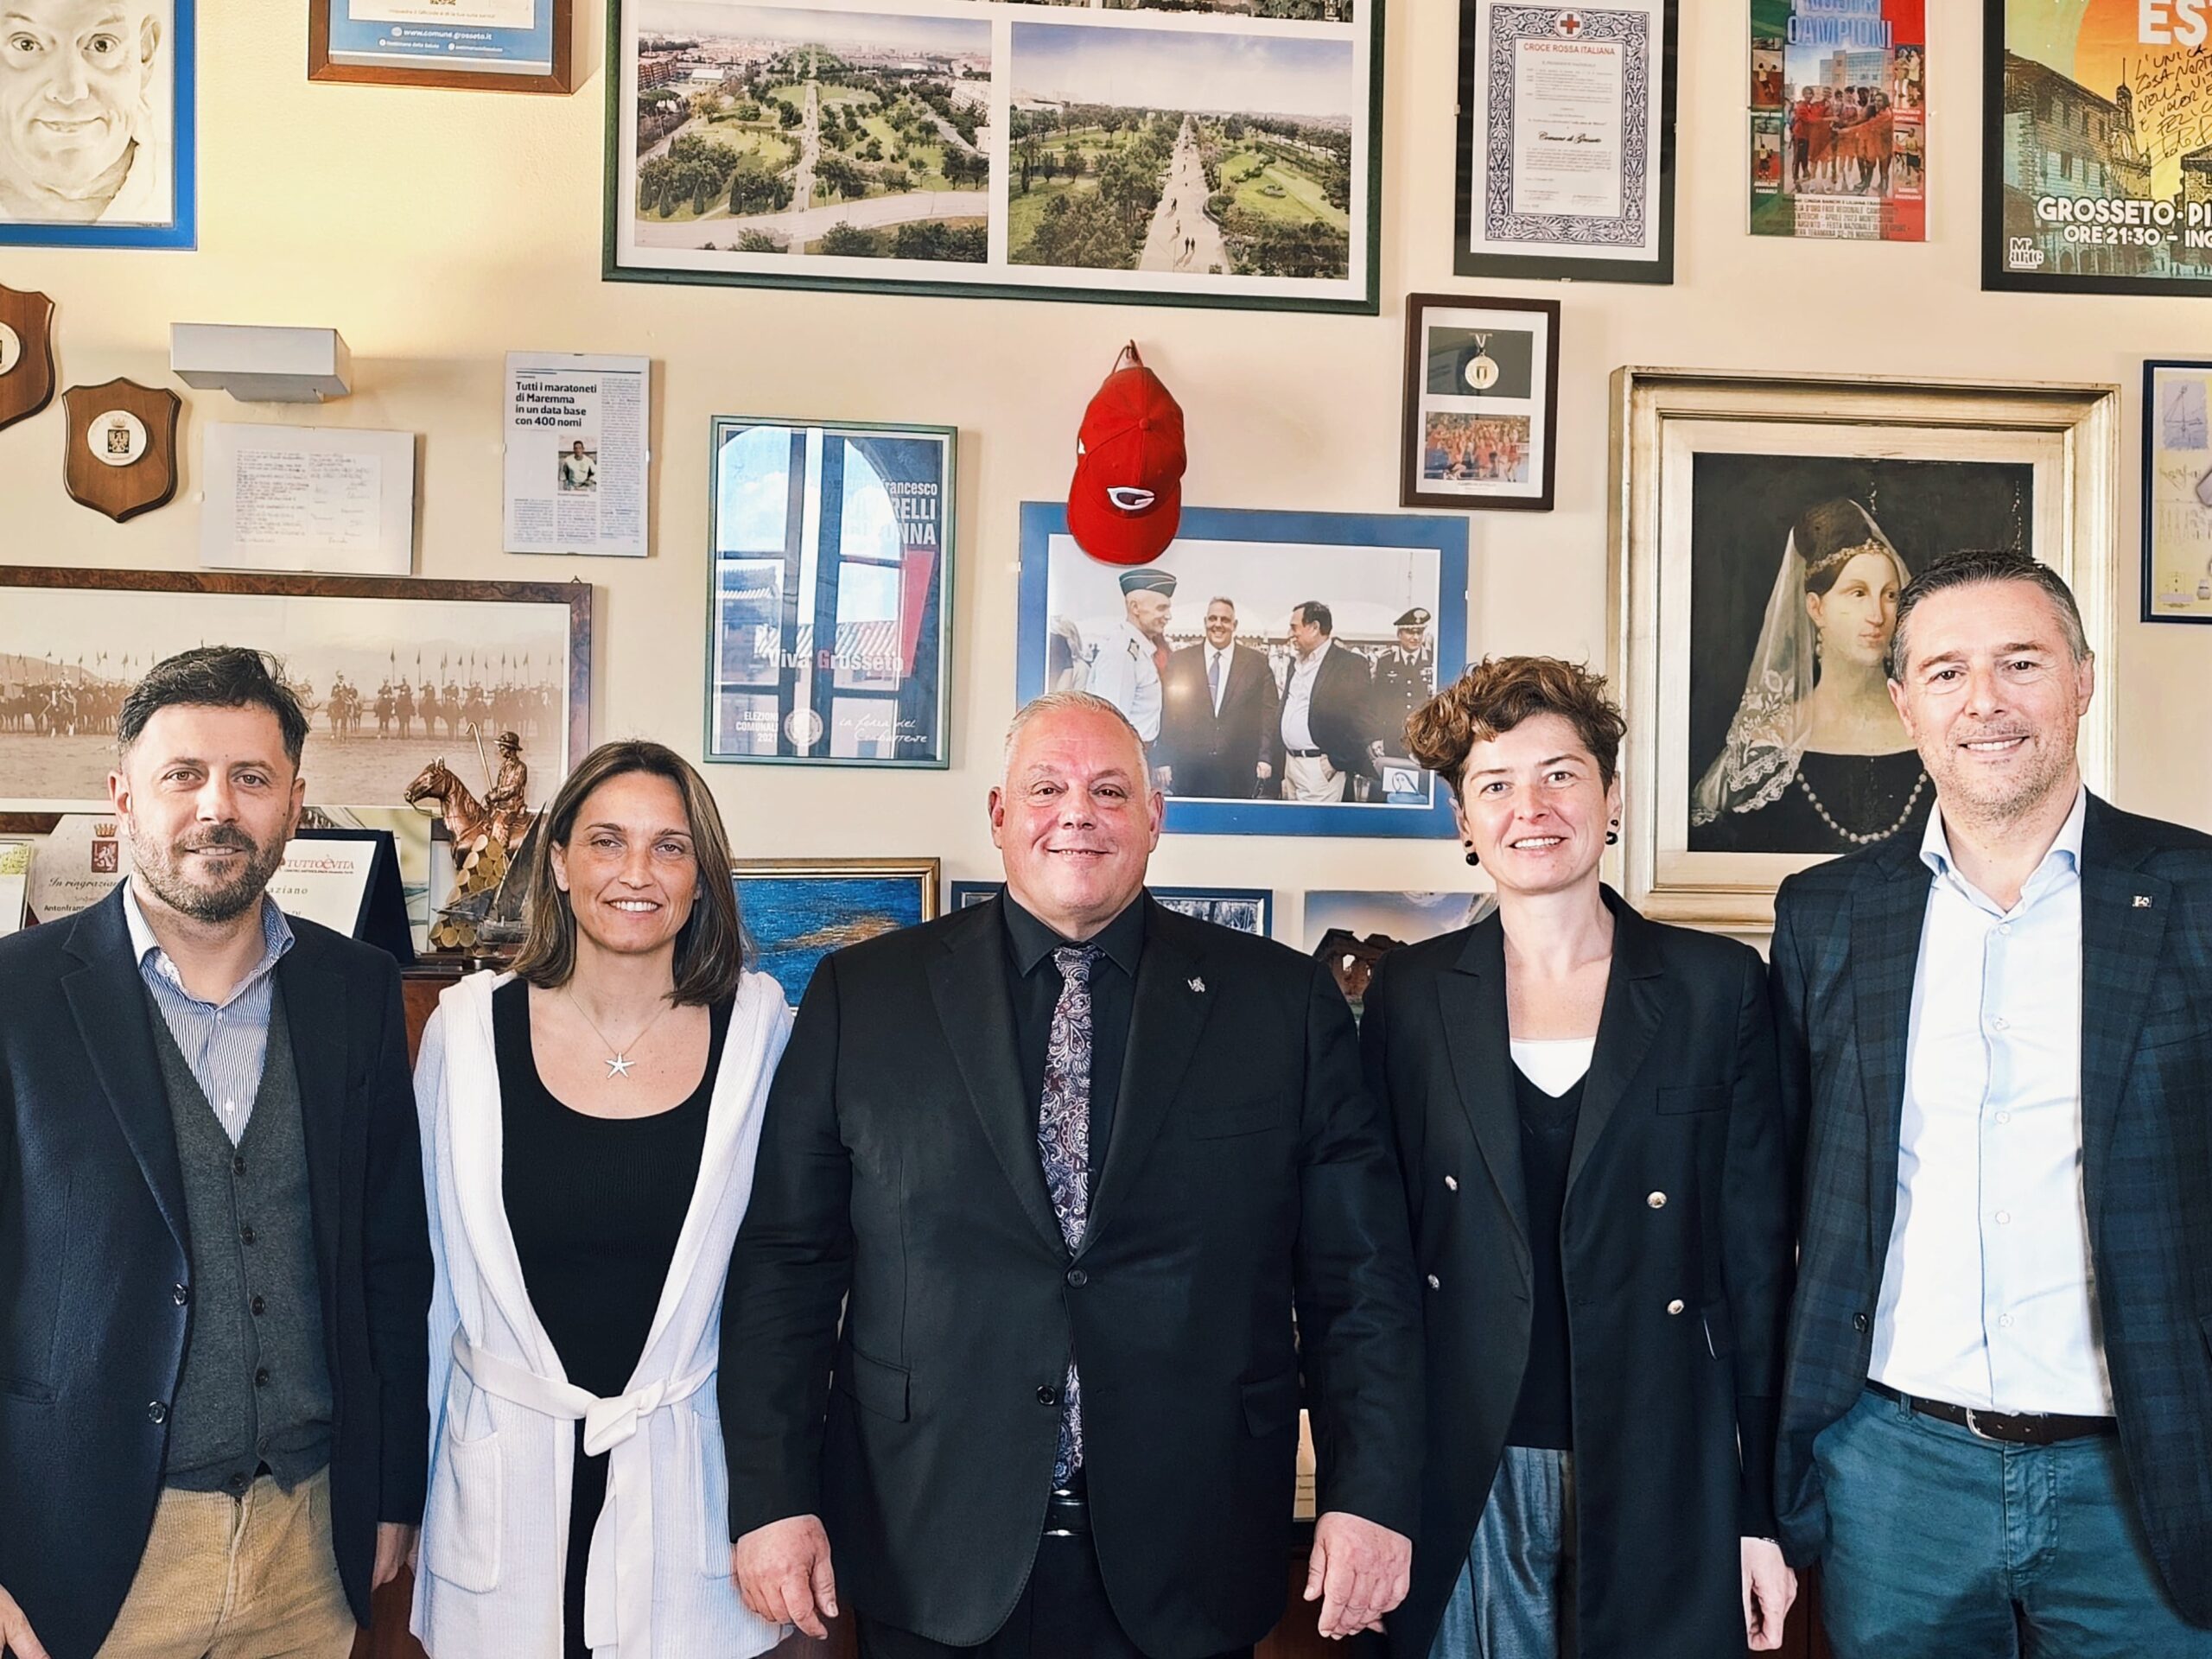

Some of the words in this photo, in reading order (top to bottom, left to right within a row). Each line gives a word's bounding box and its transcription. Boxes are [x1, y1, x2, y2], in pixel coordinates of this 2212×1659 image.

[2139, 0, 2212, 47] ES
[1788, 15, 1892, 49] CAMPIONI
[1523, 42, 1550, 52] CROCE
[1580, 46, 1615, 55] ITALIANA
[2037, 196, 2176, 226] GROSSETO
[2063, 226, 2104, 244] ORE
[2106, 226, 2160, 245] 21:30
[516, 382, 537, 391] Tutti
[544, 384, 597, 393] maratoneti
[516, 393, 524, 402] di
[526, 393, 575, 404] Maremma
[516, 404, 524, 413] in
[540, 405, 562, 415] data
[563, 406, 587, 416] base
[534, 416, 556, 426] 400
[557, 418, 582, 427] nomi
[883, 480, 938, 496] rancesco
[769, 648, 810, 668] Viva
[817, 649, 905, 671] Grosseto
[48, 878, 63, 887] In
